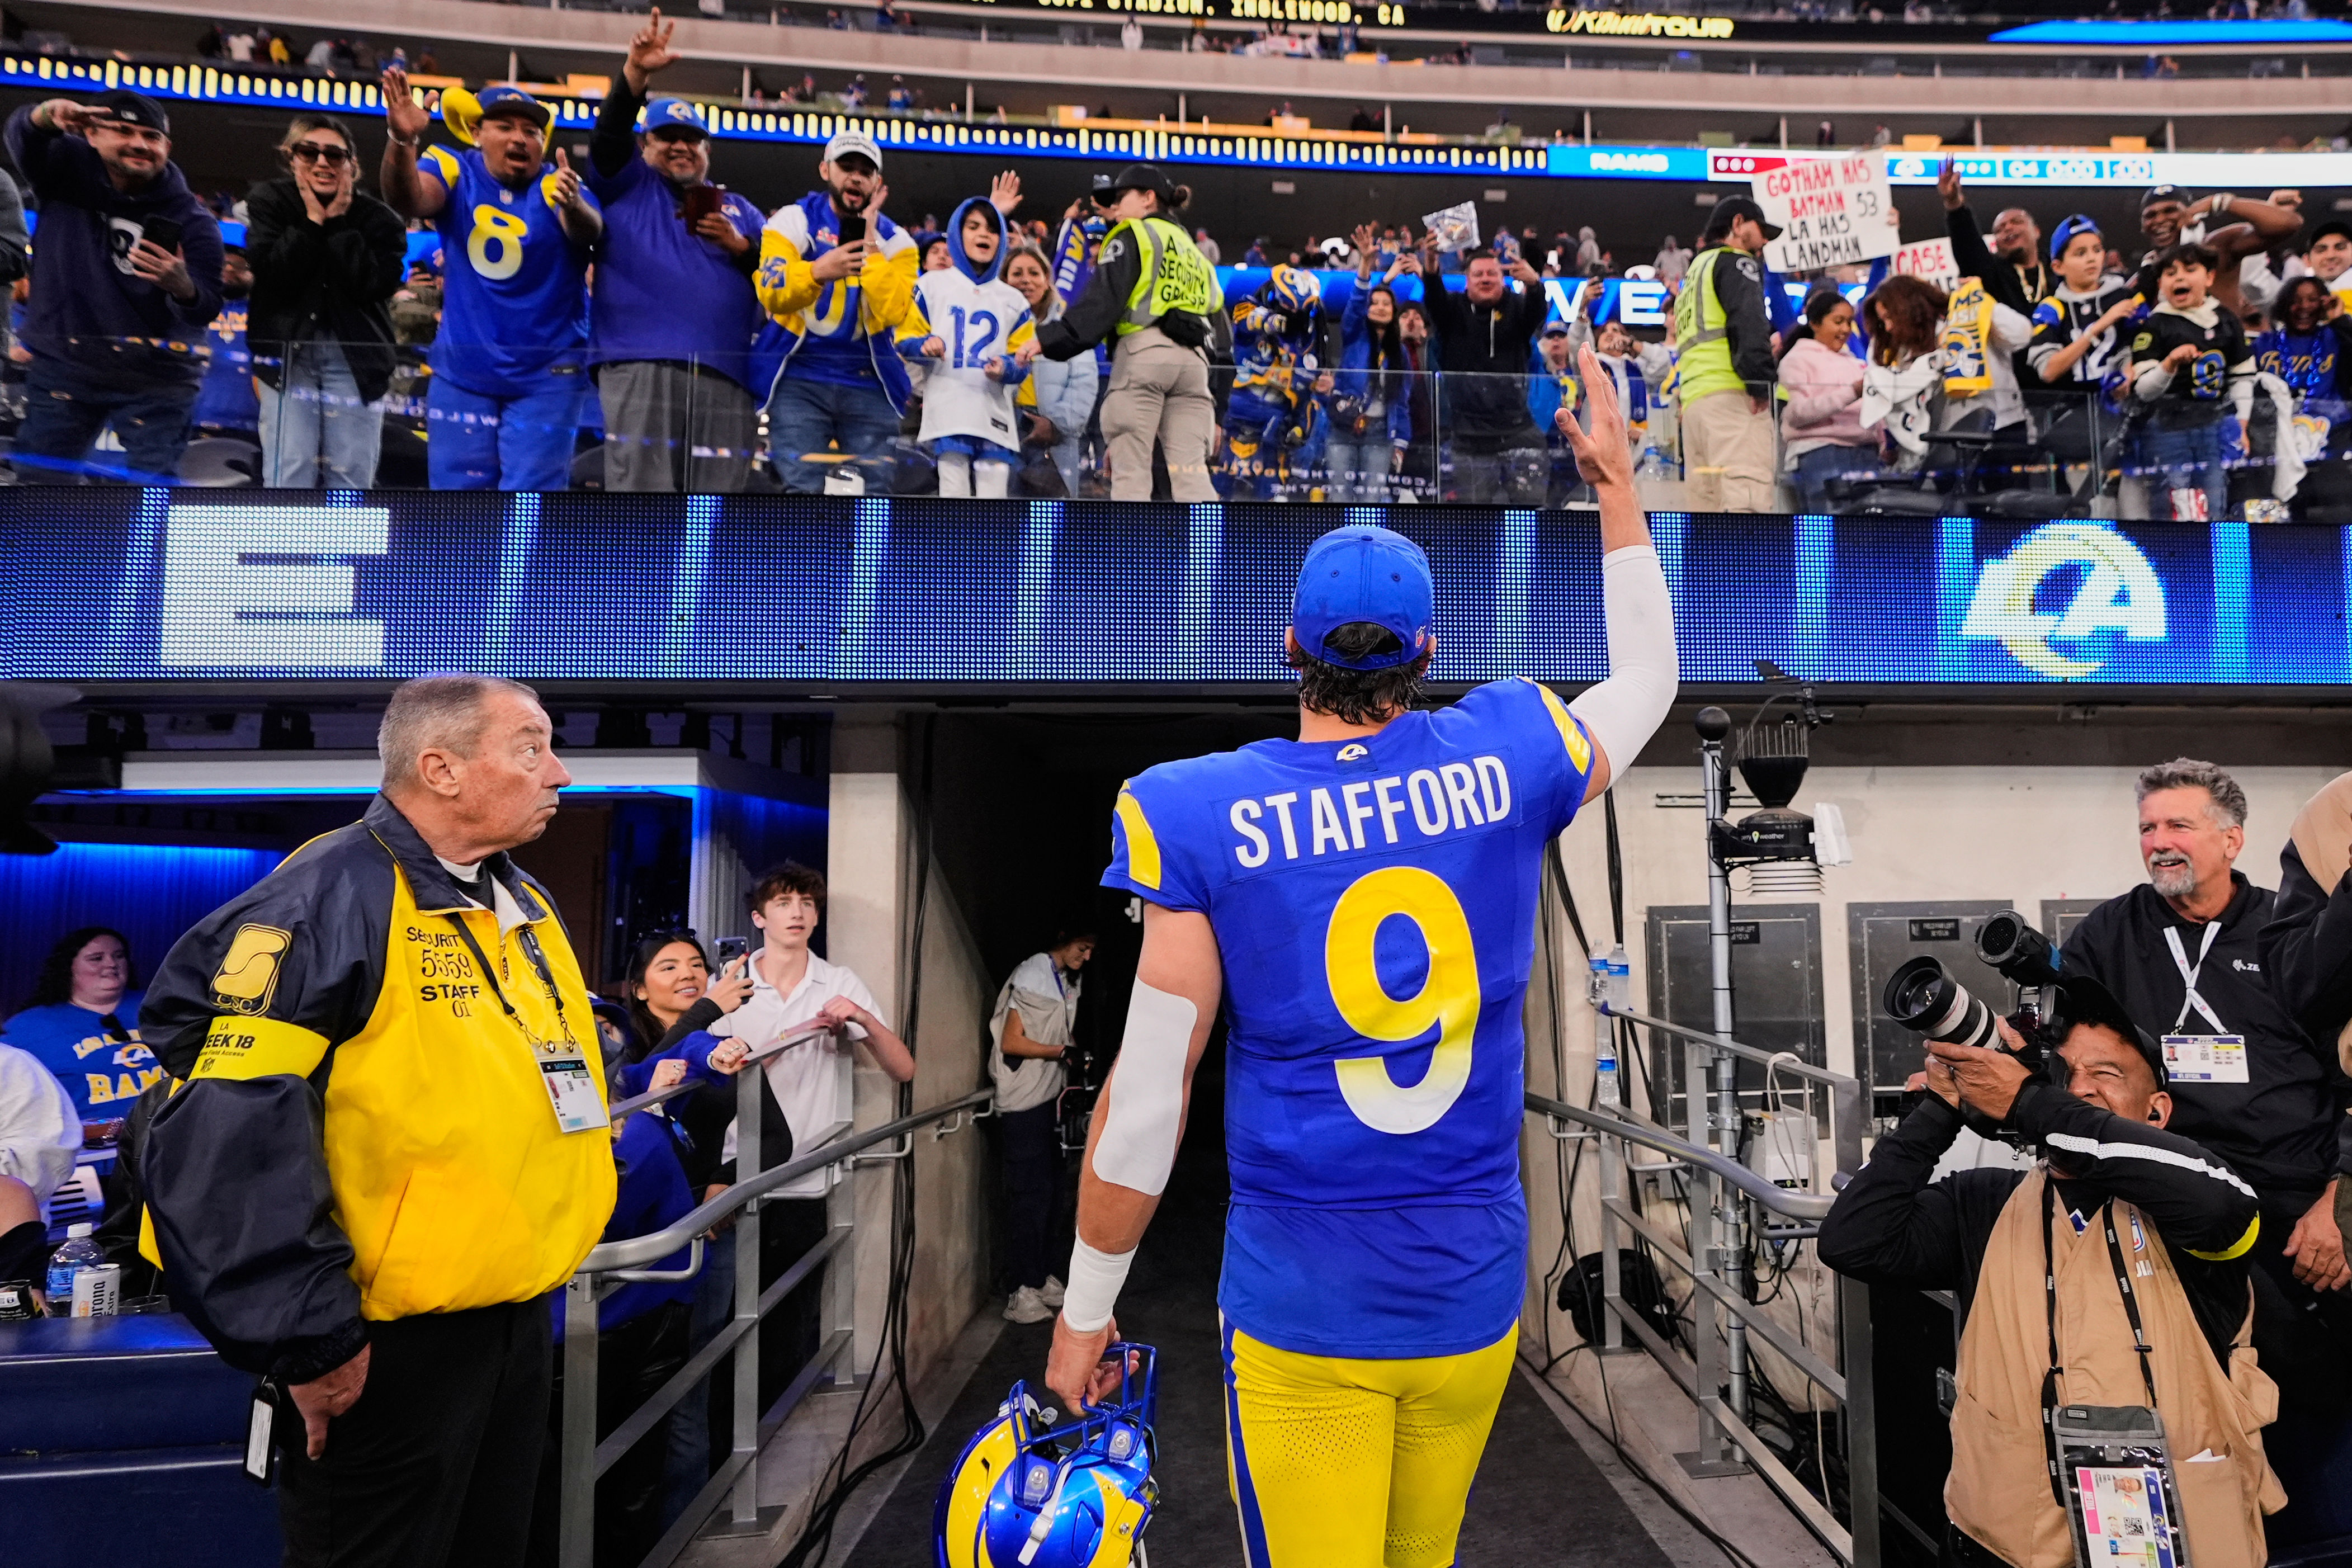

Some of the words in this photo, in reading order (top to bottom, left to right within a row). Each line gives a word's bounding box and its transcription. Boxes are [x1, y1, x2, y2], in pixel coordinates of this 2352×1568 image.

[1378, 4, 1405, 26] CA
[1767, 162, 1834, 196] GOTHAM
[1841, 159, 1871, 184] HAS
[1790, 190, 1845, 218] BATMAN
[1857, 191, 1878, 217] 53
[467, 204, 528, 280] 8
[1789, 221, 1809, 240] LA
[1819, 215, 1850, 237] HAS
[1166, 235, 1202, 275] AEX
[1783, 236, 1862, 268] LANDMAN
[1897, 244, 1947, 274] CASE
[1159, 258, 1205, 294] SECURITY
[949, 305, 1000, 369] 12
[160, 505, 390, 666] E
[1230, 755, 1512, 868] STAFFORD
[407, 927, 461, 947] SECURIT
[421, 949, 473, 979] 5559
[2247, 962, 2260, 972] ZE
[217, 994, 252, 1013] CSC
[421, 985, 479, 1002] STAFF
[1325, 866, 1481, 1135] 9
[452, 1000, 472, 1018] 01
[205, 1034, 235, 1049] EEK
[235, 1035, 256, 1049] 18
[219, 1023, 229, 1031] LA
[85, 1064, 171, 1104] RAM
[2083, 1491, 2096, 1511] MEDIA
